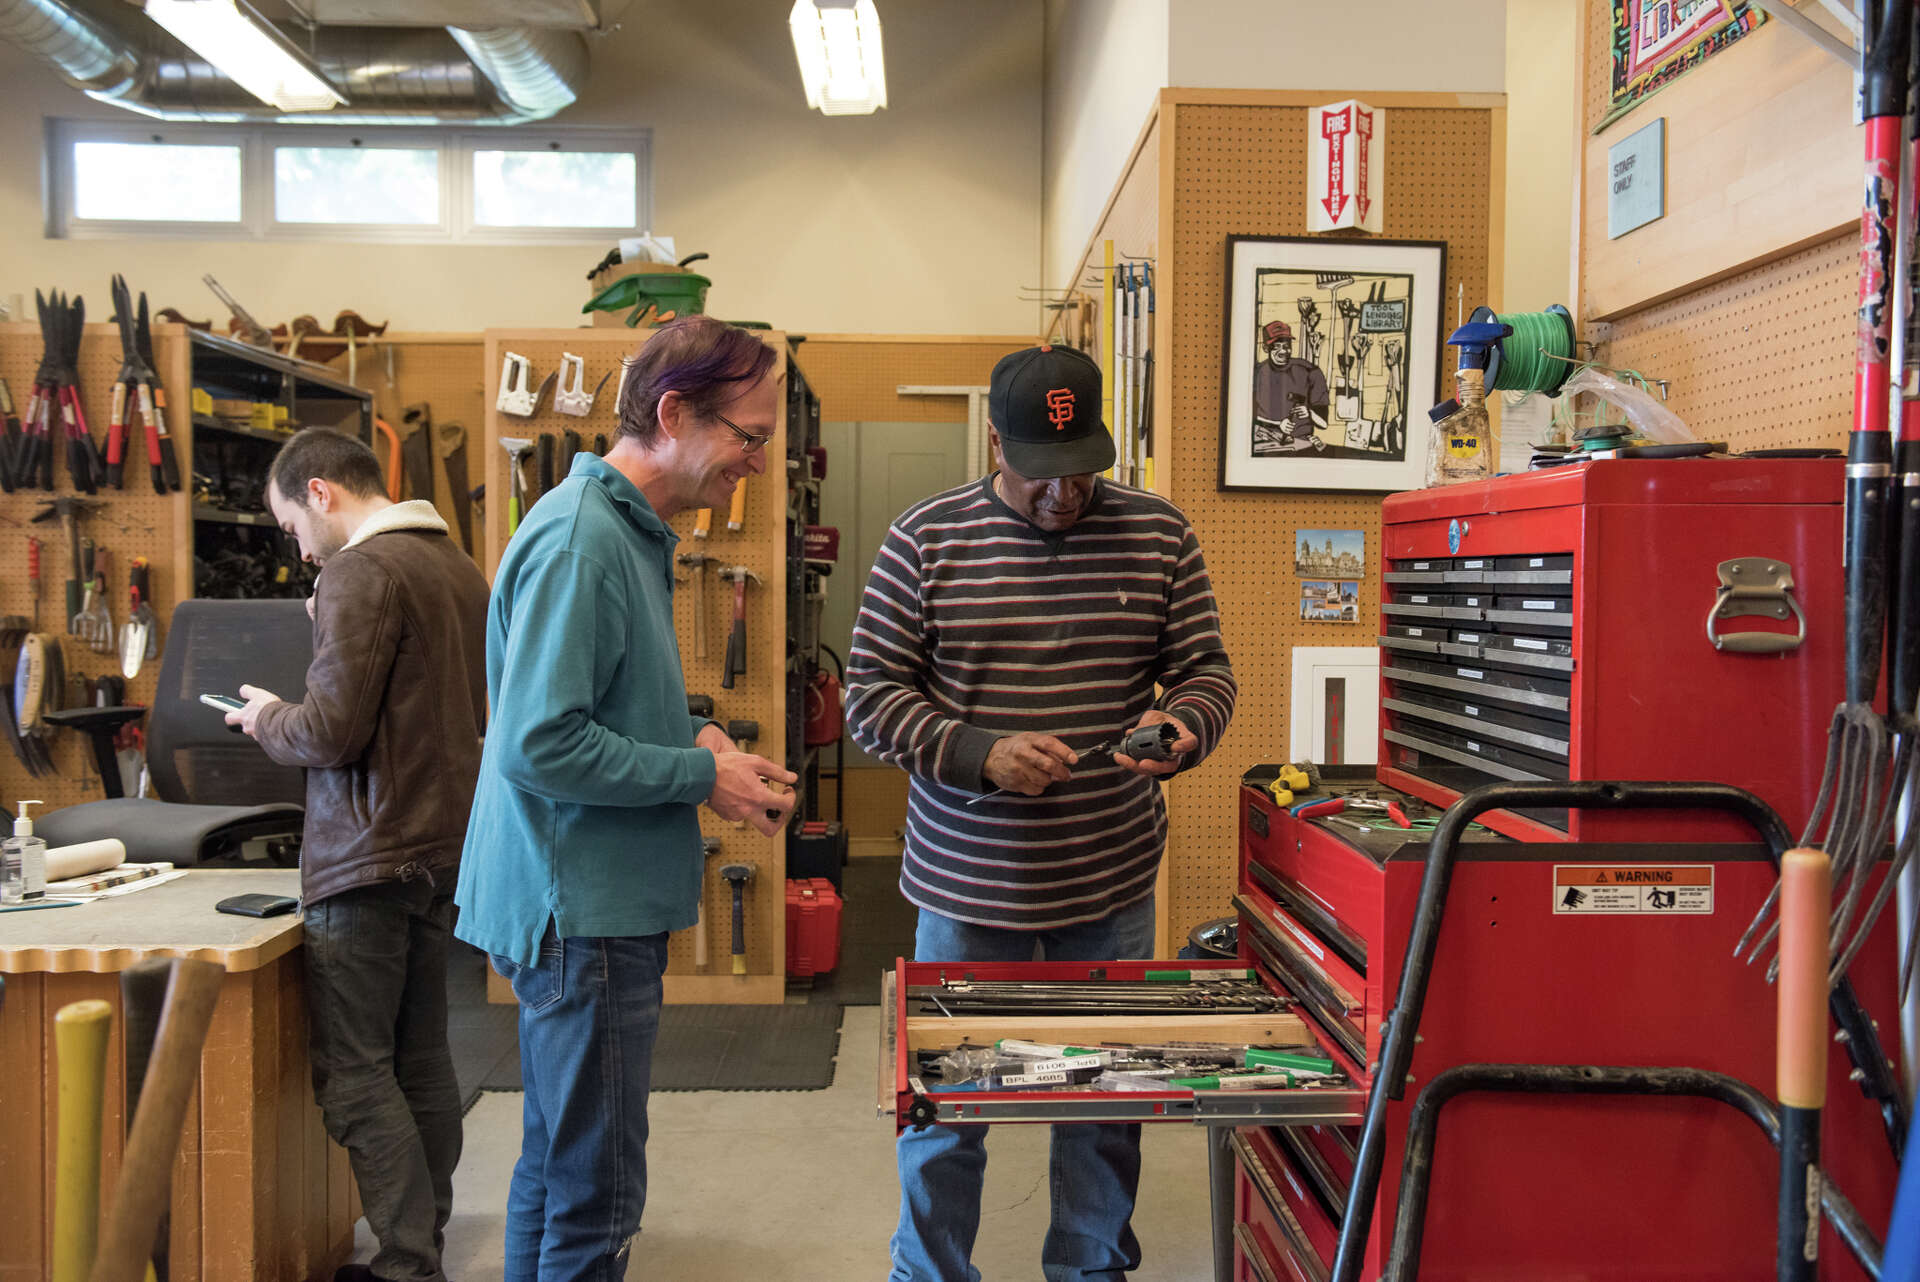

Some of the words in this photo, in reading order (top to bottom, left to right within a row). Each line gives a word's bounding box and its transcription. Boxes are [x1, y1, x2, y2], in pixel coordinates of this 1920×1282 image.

[1641, 0, 1707, 49] LIBR
[1327, 114, 1347, 134] FIRE
[1613, 153, 1636, 178] STAFF
[1613, 173, 1633, 195] ONLY
[1365, 311, 1403, 320] LENDING
[1365, 319, 1402, 328] LIBRARY
[1451, 439, 1476, 448] WD-40
[1614, 871, 1673, 883] WARNING
[1006, 1076, 1028, 1084] BPL
